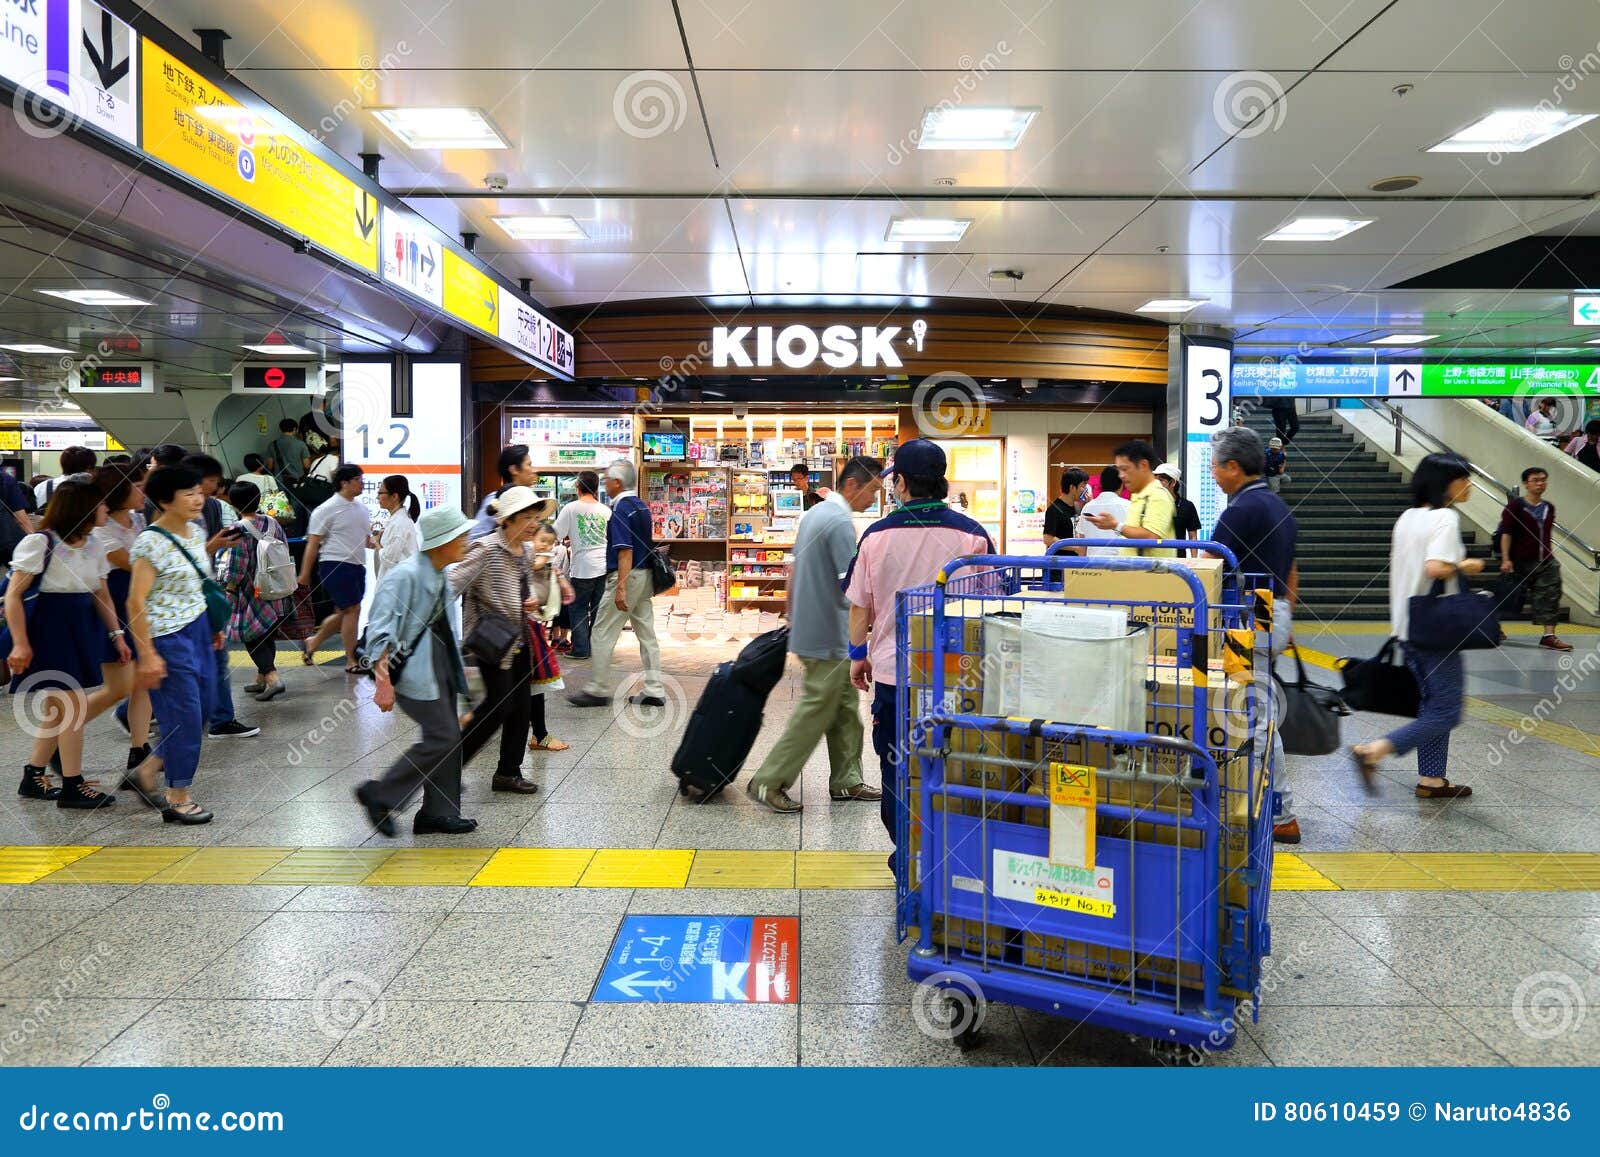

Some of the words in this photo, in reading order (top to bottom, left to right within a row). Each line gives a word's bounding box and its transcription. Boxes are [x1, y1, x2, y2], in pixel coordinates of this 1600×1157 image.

[162, 61, 195, 96] 地下鉄
[94, 86, 115, 110] 下る
[173, 106, 204, 138] 地下鉄
[712, 325, 903, 368] KIOSK
[102, 371, 140, 384] 中央線
[1200, 369, 1223, 426] 3
[1037, 893, 1070, 906] みやげ
